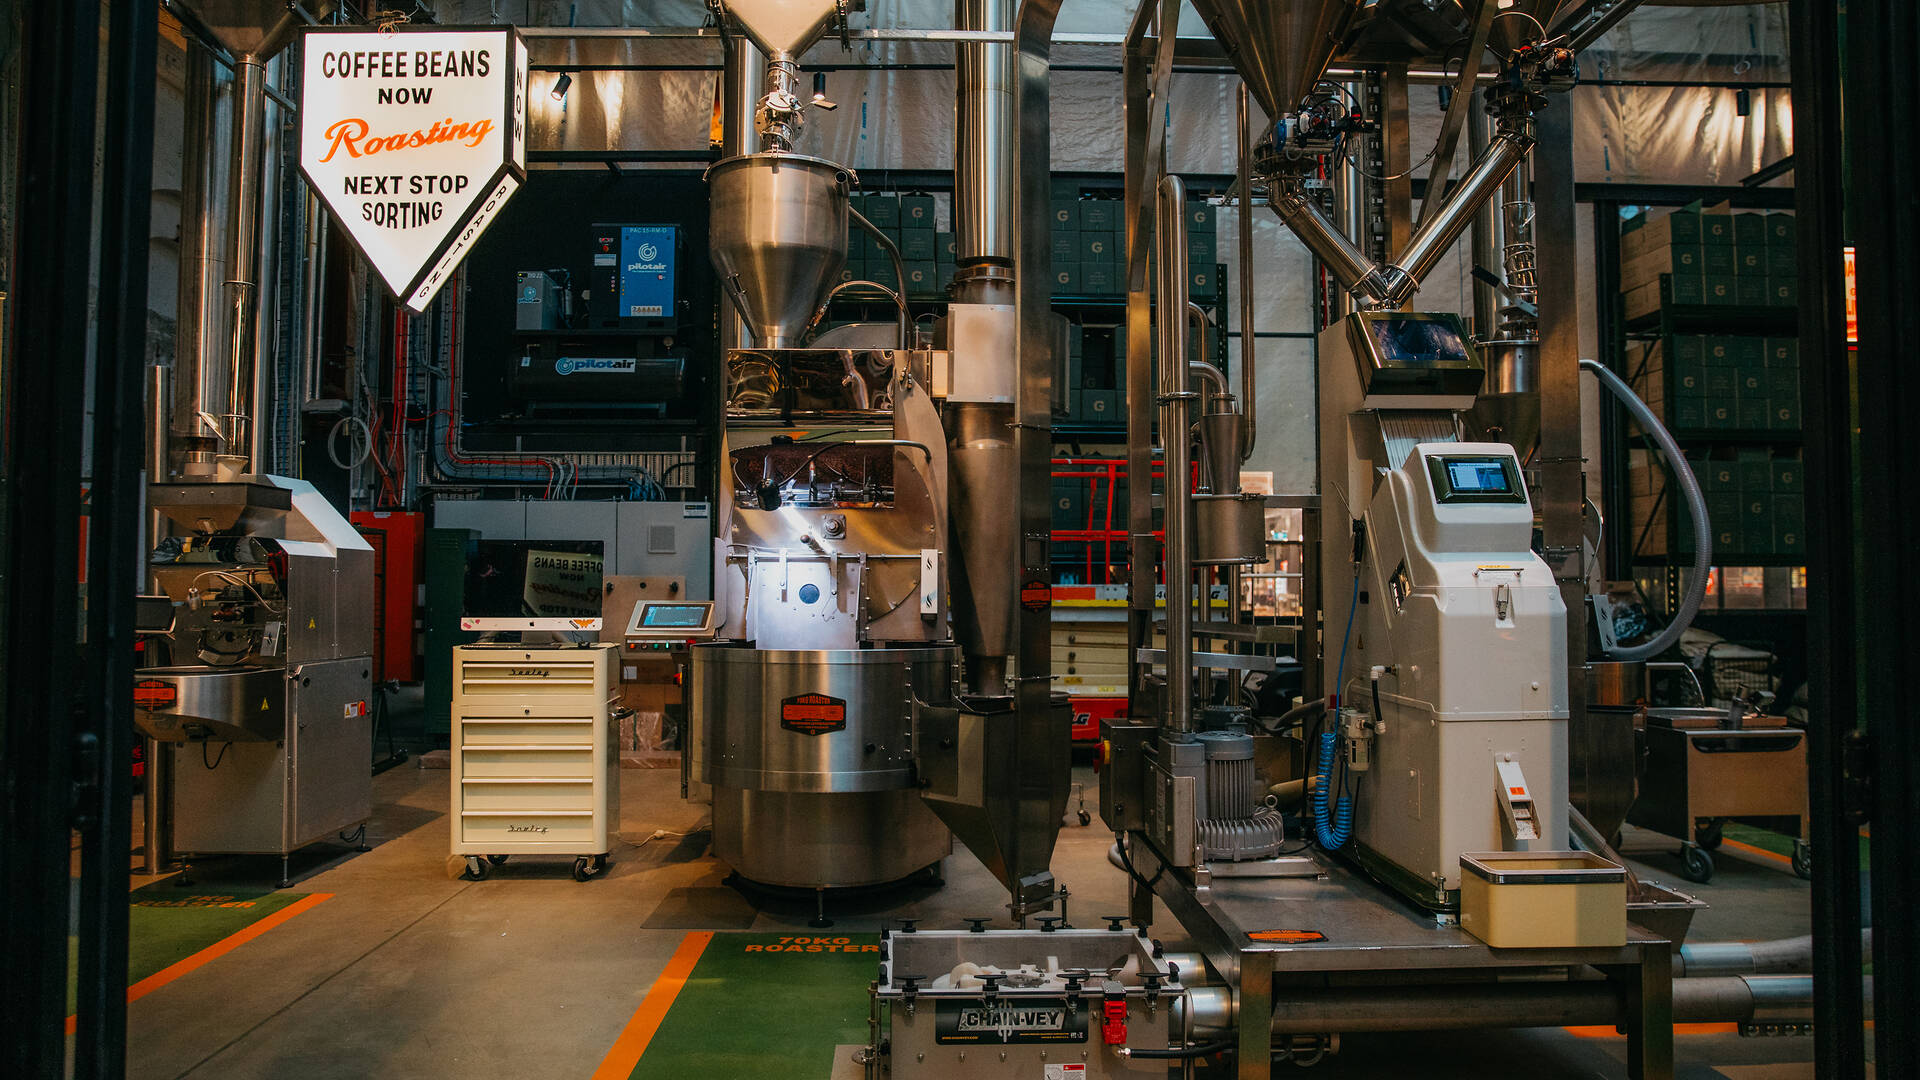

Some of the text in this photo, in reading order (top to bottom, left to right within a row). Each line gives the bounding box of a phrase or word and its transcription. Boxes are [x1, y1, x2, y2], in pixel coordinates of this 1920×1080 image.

[322, 50, 490, 79] COFFEE BEANS
[378, 88, 433, 105] NOW
[514, 66, 523, 142] NOW
[318, 118, 495, 163] Roasting
[344, 175, 469, 195] NEXT STOP
[362, 201, 443, 229] SORTING
[911, 207, 923, 218] G
[1057, 210, 1069, 222] G
[1194, 212, 1206, 223] G
[1712, 224, 1723, 236] G
[419, 185, 507, 298] ROASTING
[1091, 242, 1103, 253] G
[1681, 253, 1693, 265] G
[628, 262, 667, 272] pilotair
[911, 271, 922, 282] G
[1058, 272, 1069, 284] G
[1194, 274, 1206, 286] G
[1714, 285, 1726, 296] G
[1778, 286, 1790, 297] G
[1713, 346, 1725, 357] G
[575, 359, 634, 370] pilotair
[1683, 376, 1695, 388] G
[1746, 377, 1757, 388] G
[1093, 400, 1105, 412] G
[1716, 408, 1727, 420] G
[1779, 408, 1791, 420] G
[1058, 497, 1071, 510] G
[778, 937, 850, 945] 70KG
[744, 944, 880, 952] ROASTER
